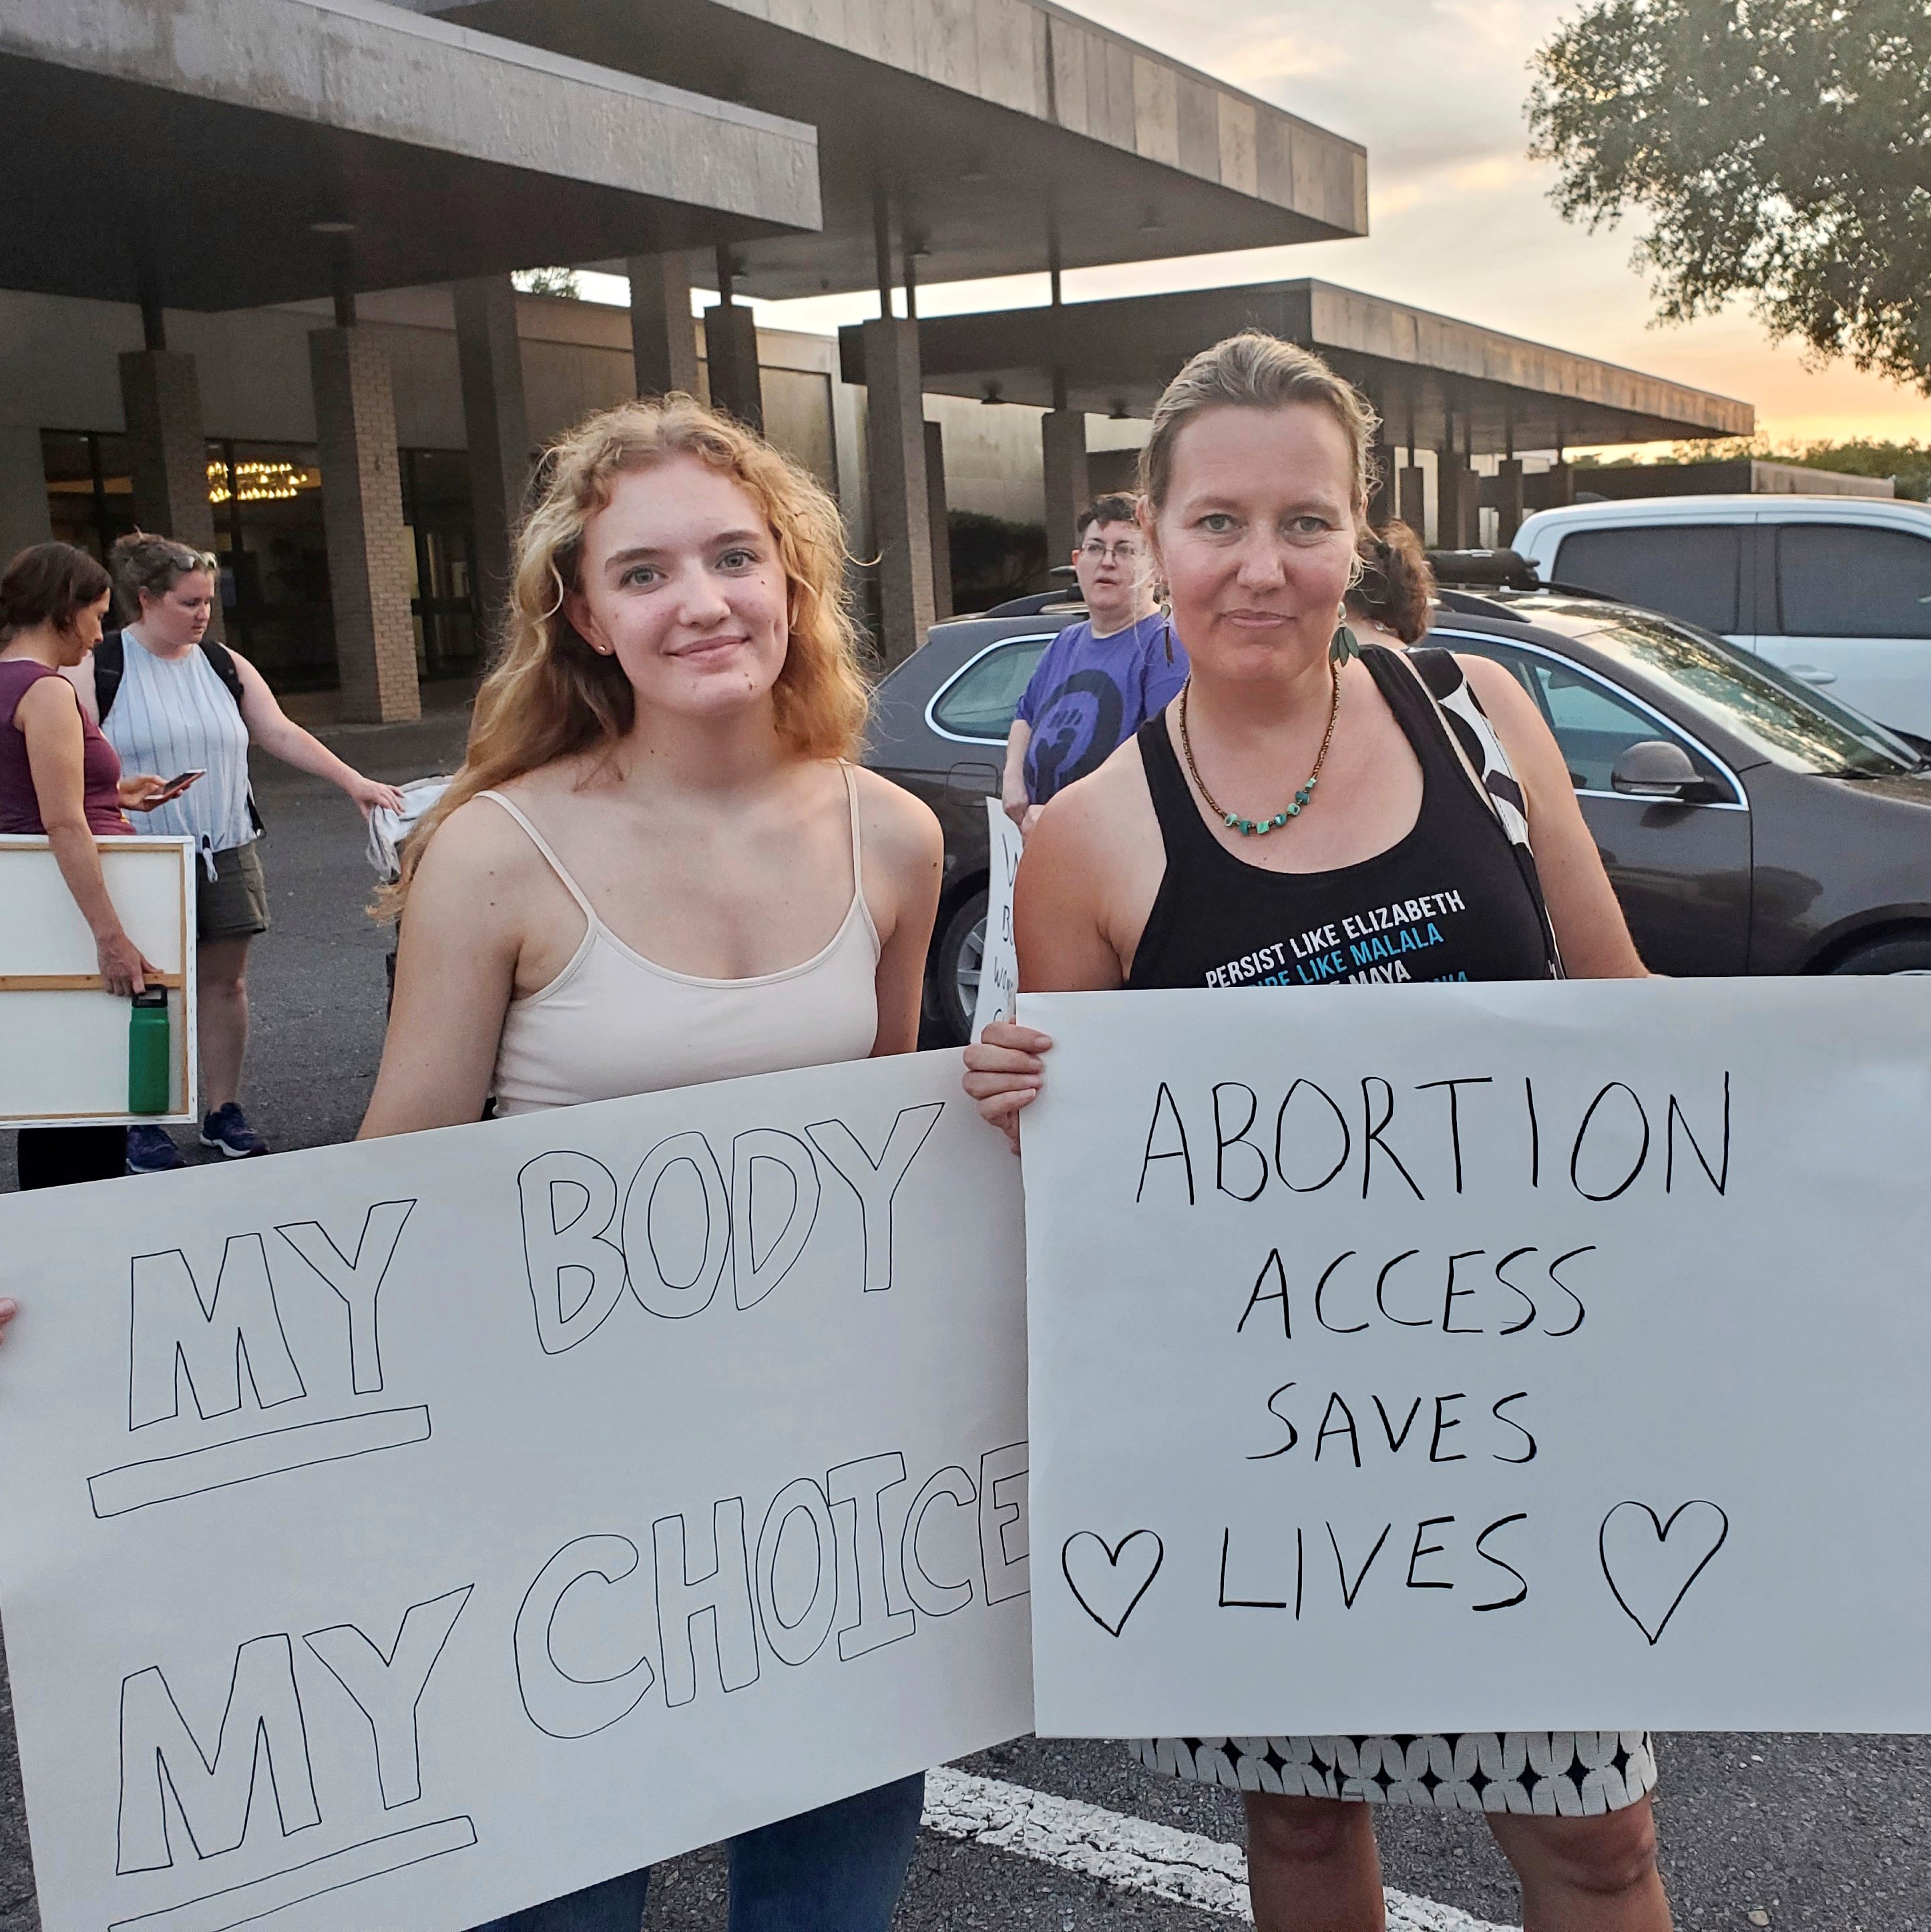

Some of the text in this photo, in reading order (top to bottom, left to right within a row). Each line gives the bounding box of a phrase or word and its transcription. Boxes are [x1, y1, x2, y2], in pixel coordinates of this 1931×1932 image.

[1205, 890, 1466, 988] PERSIST LIKE ELIZABETH
[1296, 951, 1348, 984] LIKE
[1349, 923, 1444, 966] MALALA
[1136, 1071, 1730, 1205] ABORTION
[130, 1102, 945, 1432] MY BODY
[1237, 1245, 1597, 1338] ACCESS
[1246, 1382, 1538, 1468] SAVES
[1219, 1513, 1528, 1621] LIVES
[116, 1440, 1030, 1875] MY CHOICE
